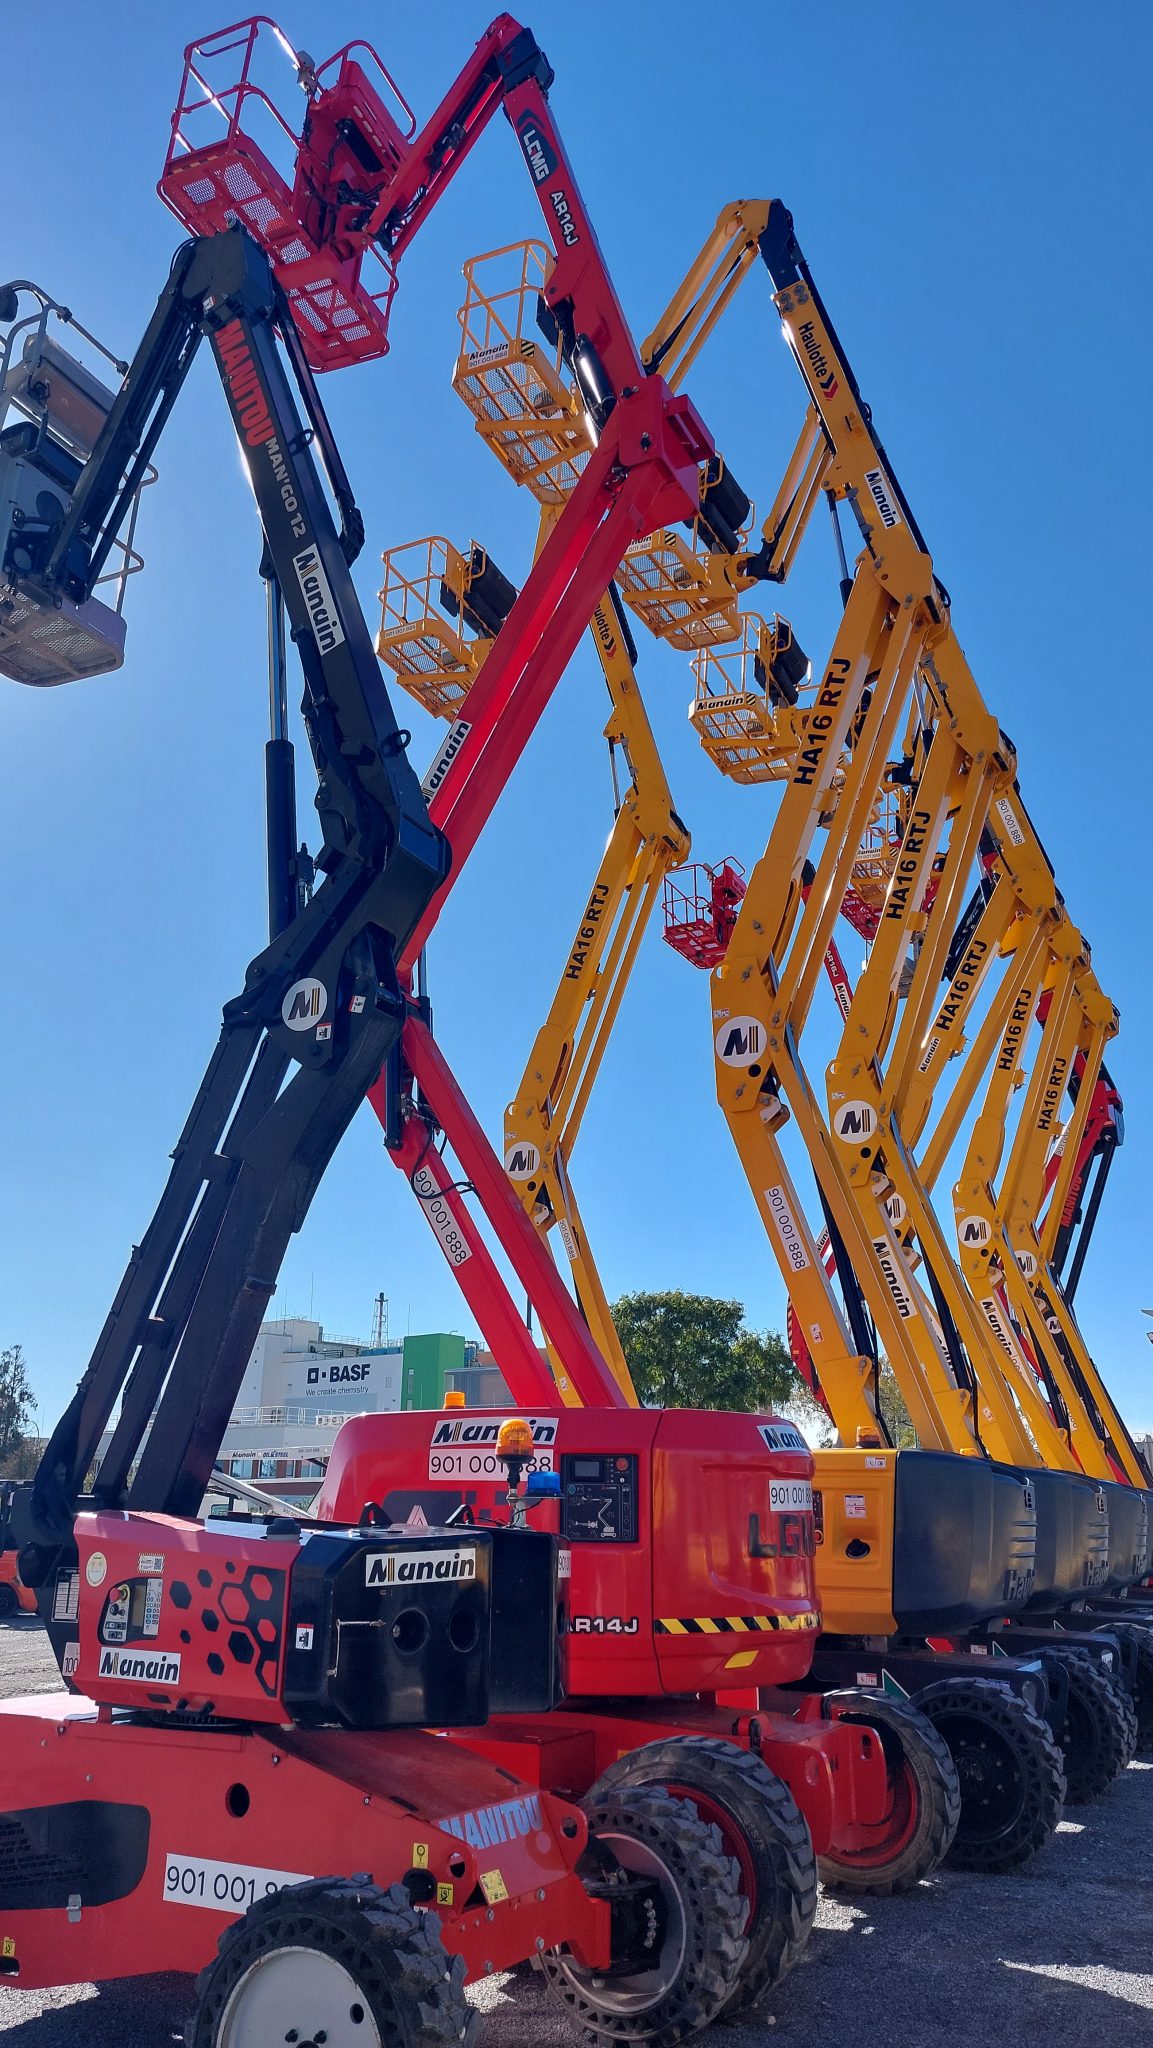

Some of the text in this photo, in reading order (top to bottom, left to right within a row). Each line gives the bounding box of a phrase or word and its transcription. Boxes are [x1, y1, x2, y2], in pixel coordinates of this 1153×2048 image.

[550, 190, 580, 247] AR14J
[469, 343, 509, 361] Manain
[799, 321, 828, 378] Haulotte
[214, 318, 276, 447] MANITOU
[265, 436, 307, 539] MAN'GO 12
[865, 471, 897, 529] Manain
[296, 551, 338, 656] Manain
[696, 697, 743, 711] Manain
[793, 658, 851, 785] HA16 RTJ
[998, 799, 1023, 845] 901 001 888
[886, 811, 931, 920] HA16 RTJ
[565, 884, 609, 979] HA16 RTJ
[836, 985, 850, 1017] Manai
[936, 940, 987, 1030] HA16 RTJ
[920, 1037, 940, 1073] Manain
[998, 989, 1032, 1070] HA16 RTJ
[1037, 1057, 1067, 1130] HA16 RTJ
[415, 1170, 467, 1263] 901 001 888
[768, 1188, 806, 1269] 901 001 888
[873, 1241, 911, 1318] Manain
[316, 1387, 337, 1396] create
[337, 1385, 369, 1395] chemistry
[329, 1363, 371, 1383] BASF
[433, 1419, 556, 1444] Manin
[431, 1456, 462, 1473] 901
[469, 1456, 504, 1473] 001
[770, 1487, 790, 1505] 901
[791, 1487, 805, 1504] 001
[368, 1553, 475, 1584] Manain
[101, 1652, 178, 1681] Manain
[166, 1866, 206, 1896] 901
[213, 1873, 256, 1905] 001
